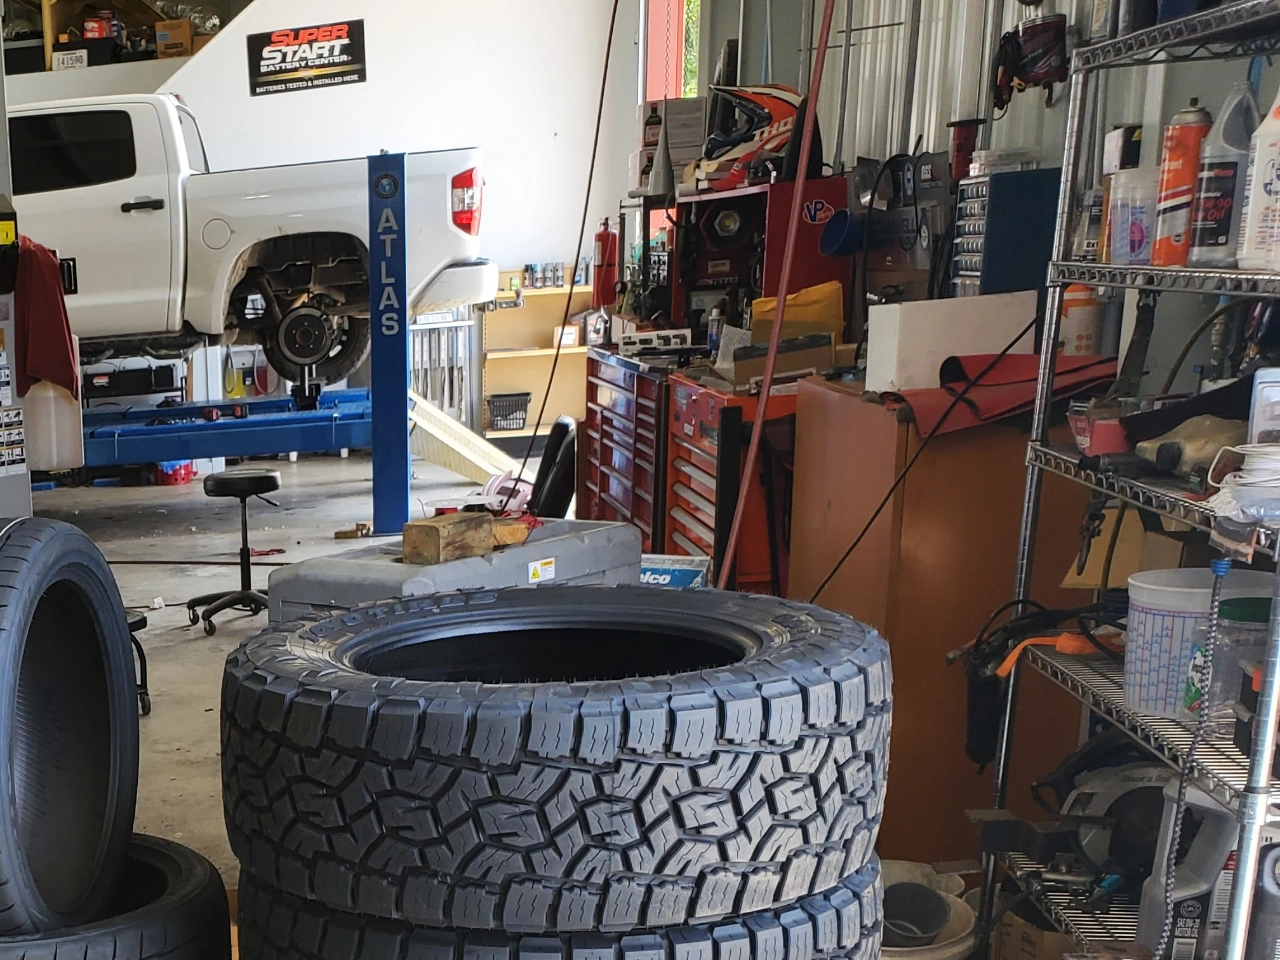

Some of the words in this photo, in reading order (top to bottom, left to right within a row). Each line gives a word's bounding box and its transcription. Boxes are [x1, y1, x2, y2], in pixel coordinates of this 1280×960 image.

[270, 24, 349, 48] SUPER
[260, 38, 351, 65] START
[260, 61, 306, 72] BATTERY
[308, 55, 348, 66] CENTER
[256, 84, 286, 93] BATTERIES
[287, 81, 307, 89] TESTED
[313, 77, 343, 85] INSTALLED
[753, 117, 794, 141] THO
[804, 200, 826, 223] VP
[377, 207, 400, 335] ATLAS
[1175, 927, 1191, 937] MOTOR
[1177, 918, 1186, 928] SAE
[1186, 918, 1200, 928] 0W-20
